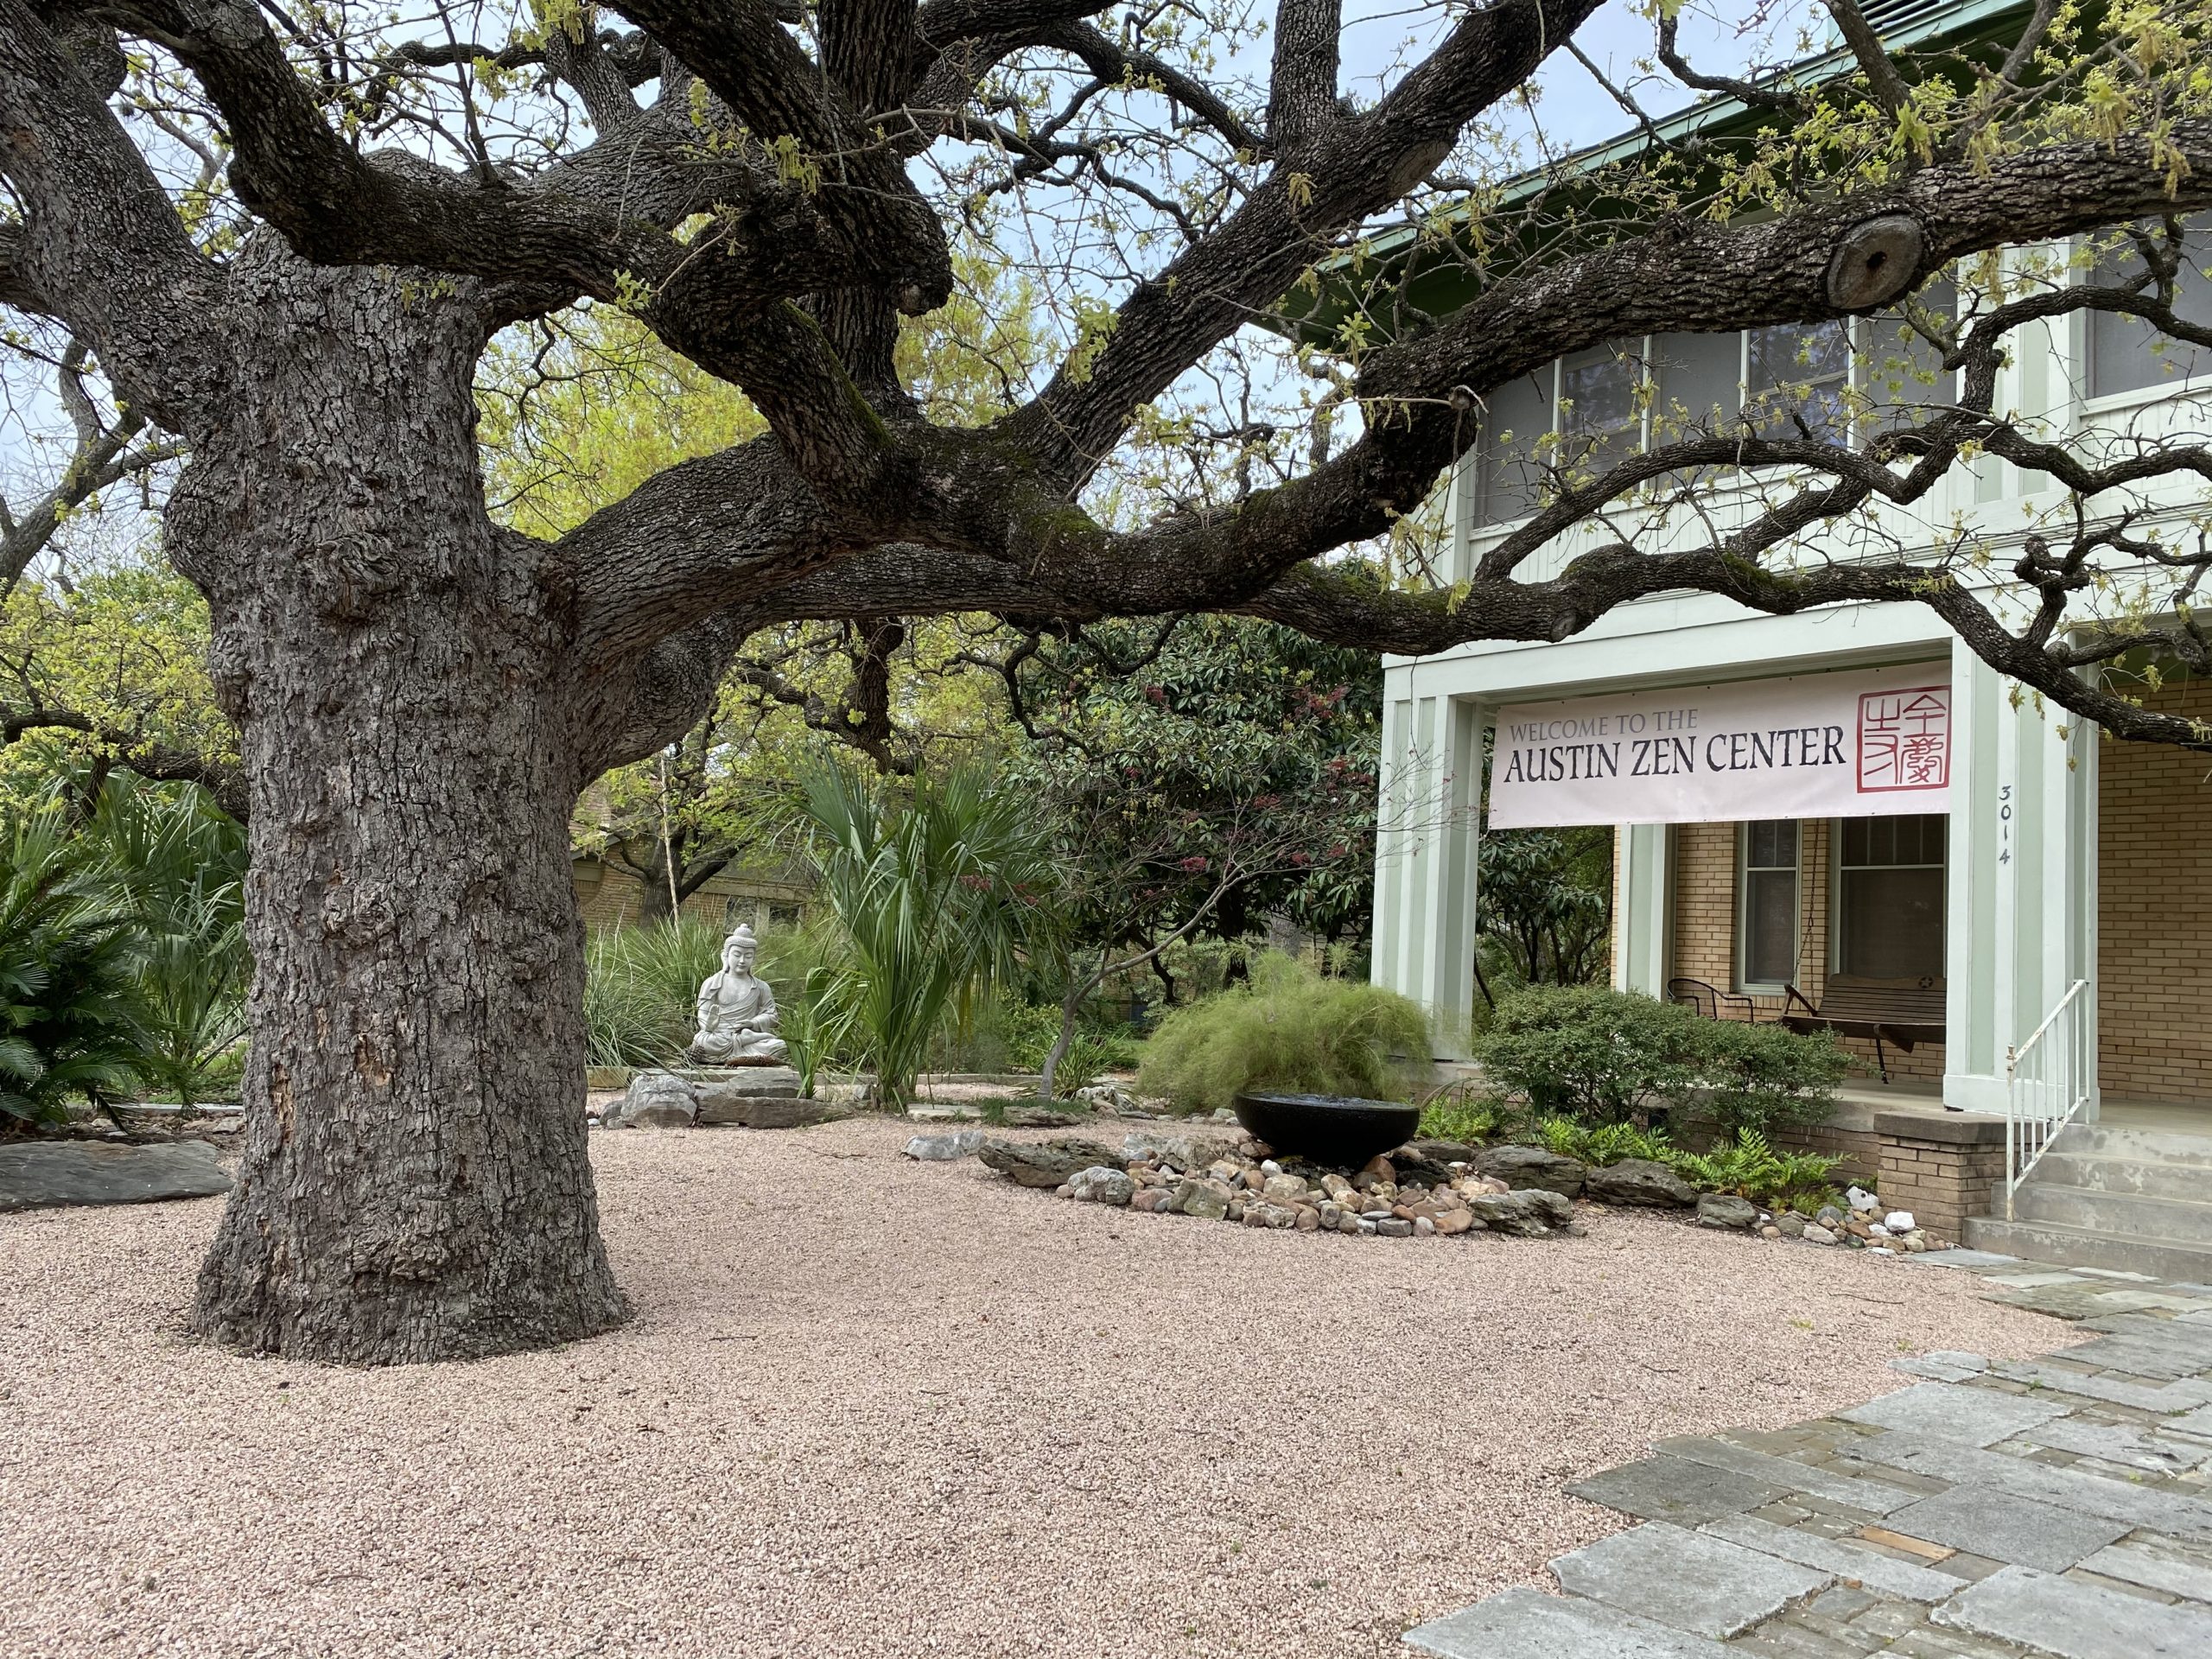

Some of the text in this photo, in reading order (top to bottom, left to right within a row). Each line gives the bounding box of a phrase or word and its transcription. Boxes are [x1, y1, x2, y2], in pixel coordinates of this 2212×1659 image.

[1503, 725, 1847, 783] AUSTIN ZEN CENTER
[1510, 709, 1699, 743] WELCOME TO THE
[1999, 785, 2012, 865] 3014
